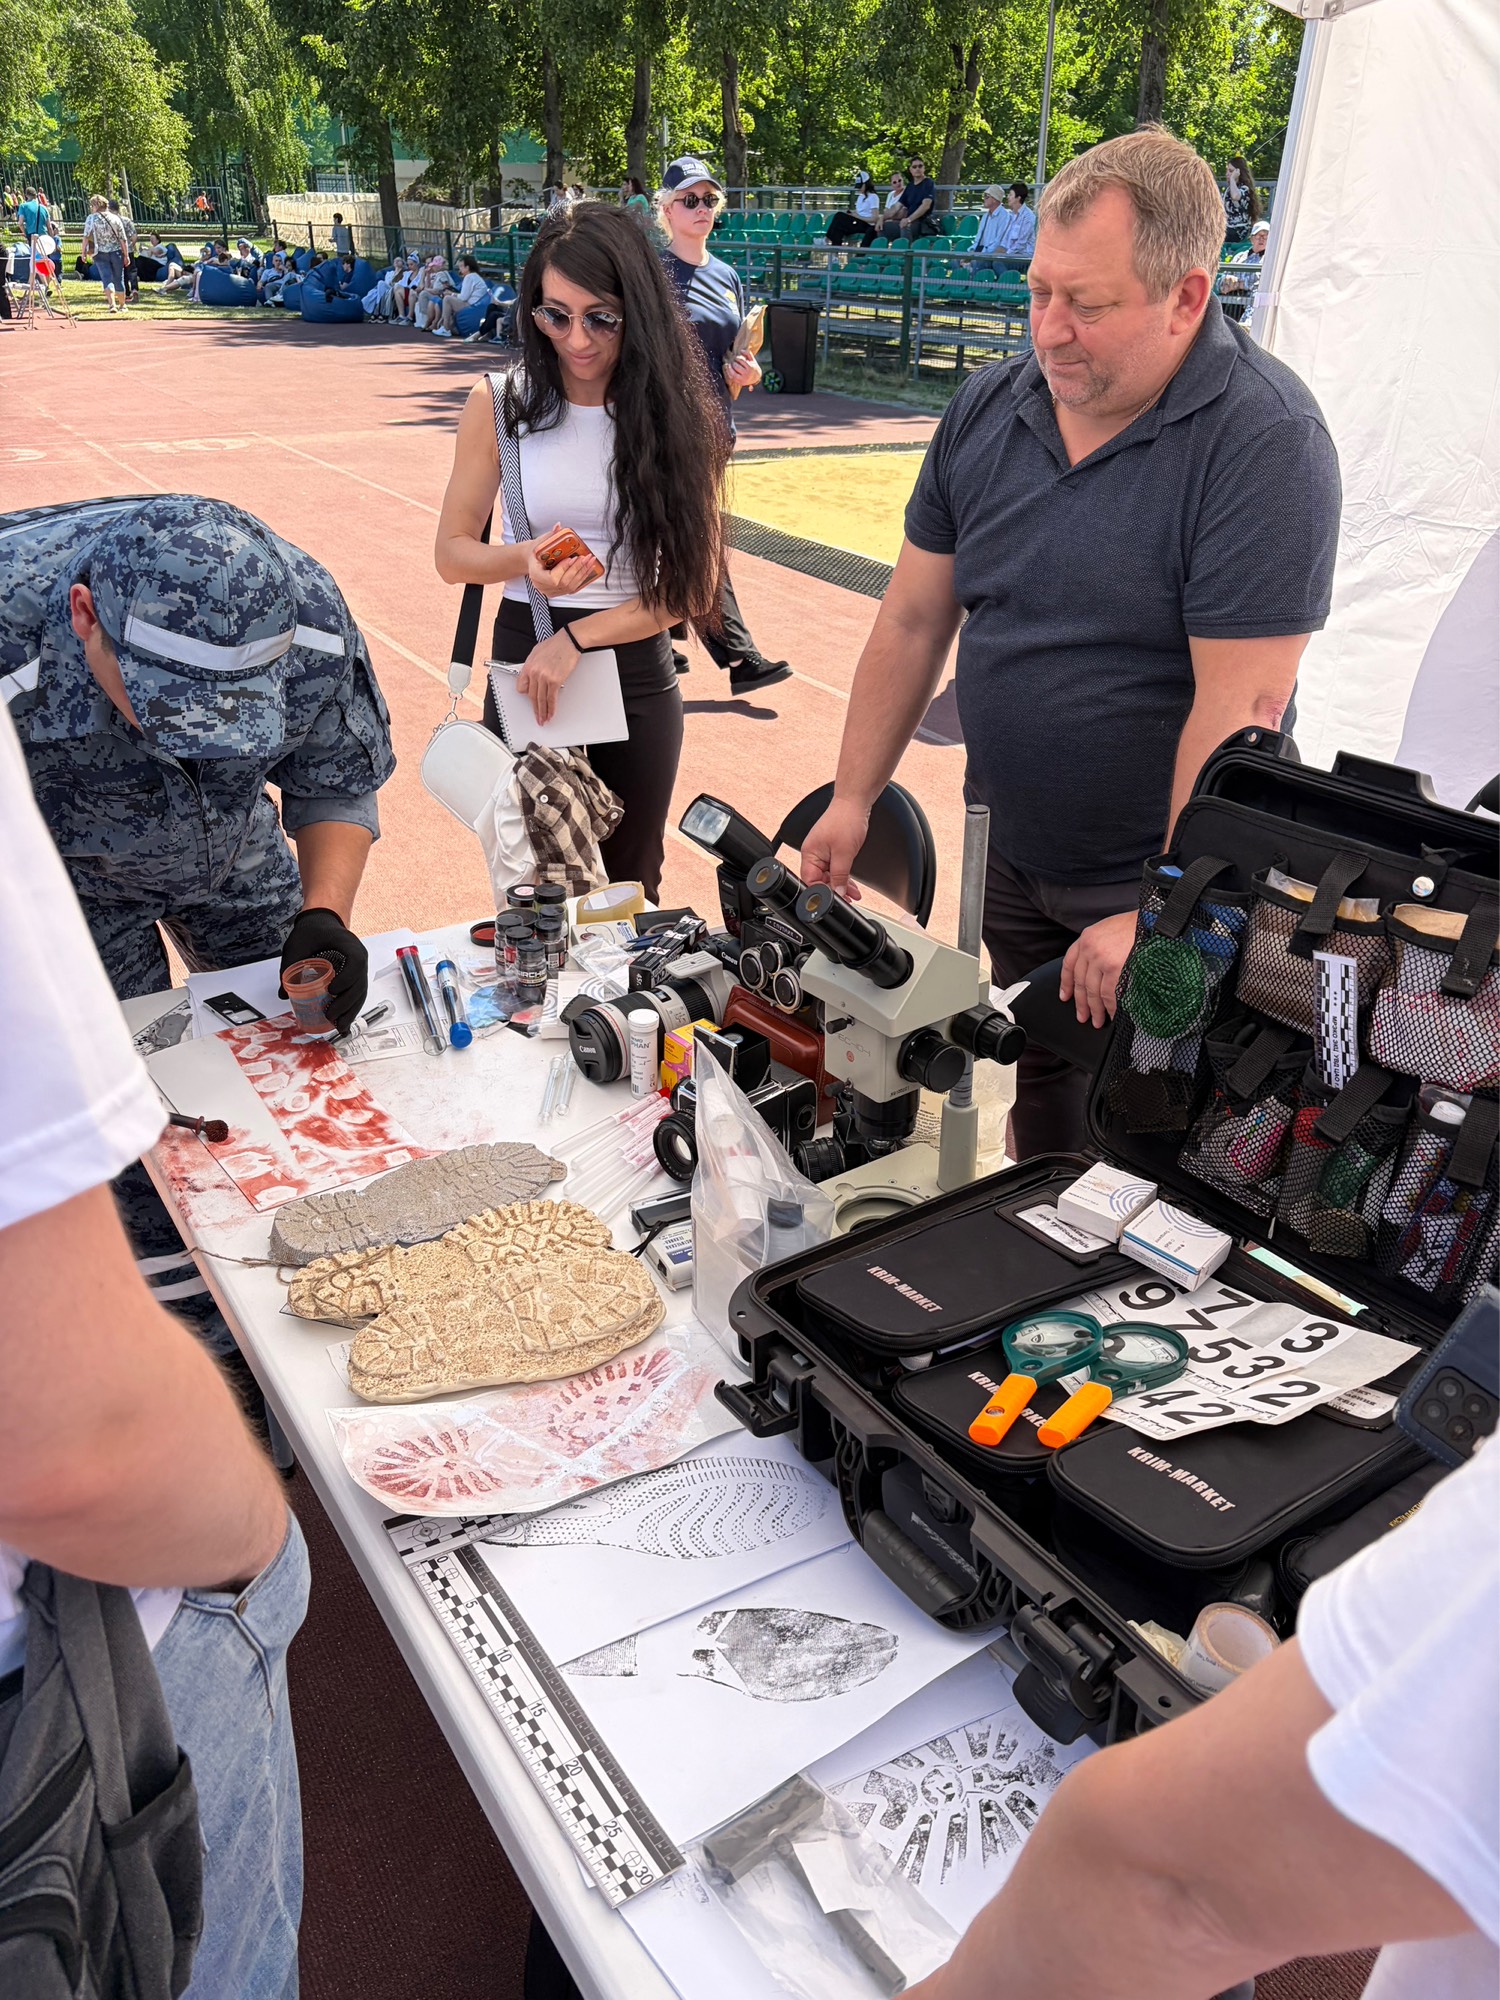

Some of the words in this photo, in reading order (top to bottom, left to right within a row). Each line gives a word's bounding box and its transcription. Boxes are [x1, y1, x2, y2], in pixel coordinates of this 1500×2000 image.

[720, 951, 739, 966] Canon
[579, 1045, 597, 1054] Canon
[866, 1265, 944, 1313] KRIM-MARKET
[1119, 1282, 1176, 1310] 9
[1201, 1288, 1255, 1315] 7
[1166, 1308, 1218, 1331] 7
[1281, 1322, 1340, 1353] 3
[1189, 1337, 1253, 1364] 5
[1223, 1355, 1286, 1379] 3
[1138, 1390, 1200, 1409] 4
[1249, 1380, 1321, 1409] 2
[1161, 1403, 1235, 1425] 2
[1126, 1446, 1237, 1513] KRIM-MARKET
[436, 1555, 449, 1564] 0
[465, 1600, 479, 1609] 5
[496, 1649, 513, 1663] 10
[529, 1702, 547, 1718] 15
[564, 1759, 584, 1777] 20
[603, 1820, 623, 1838] 25
[634, 1865, 654, 1886] 30
